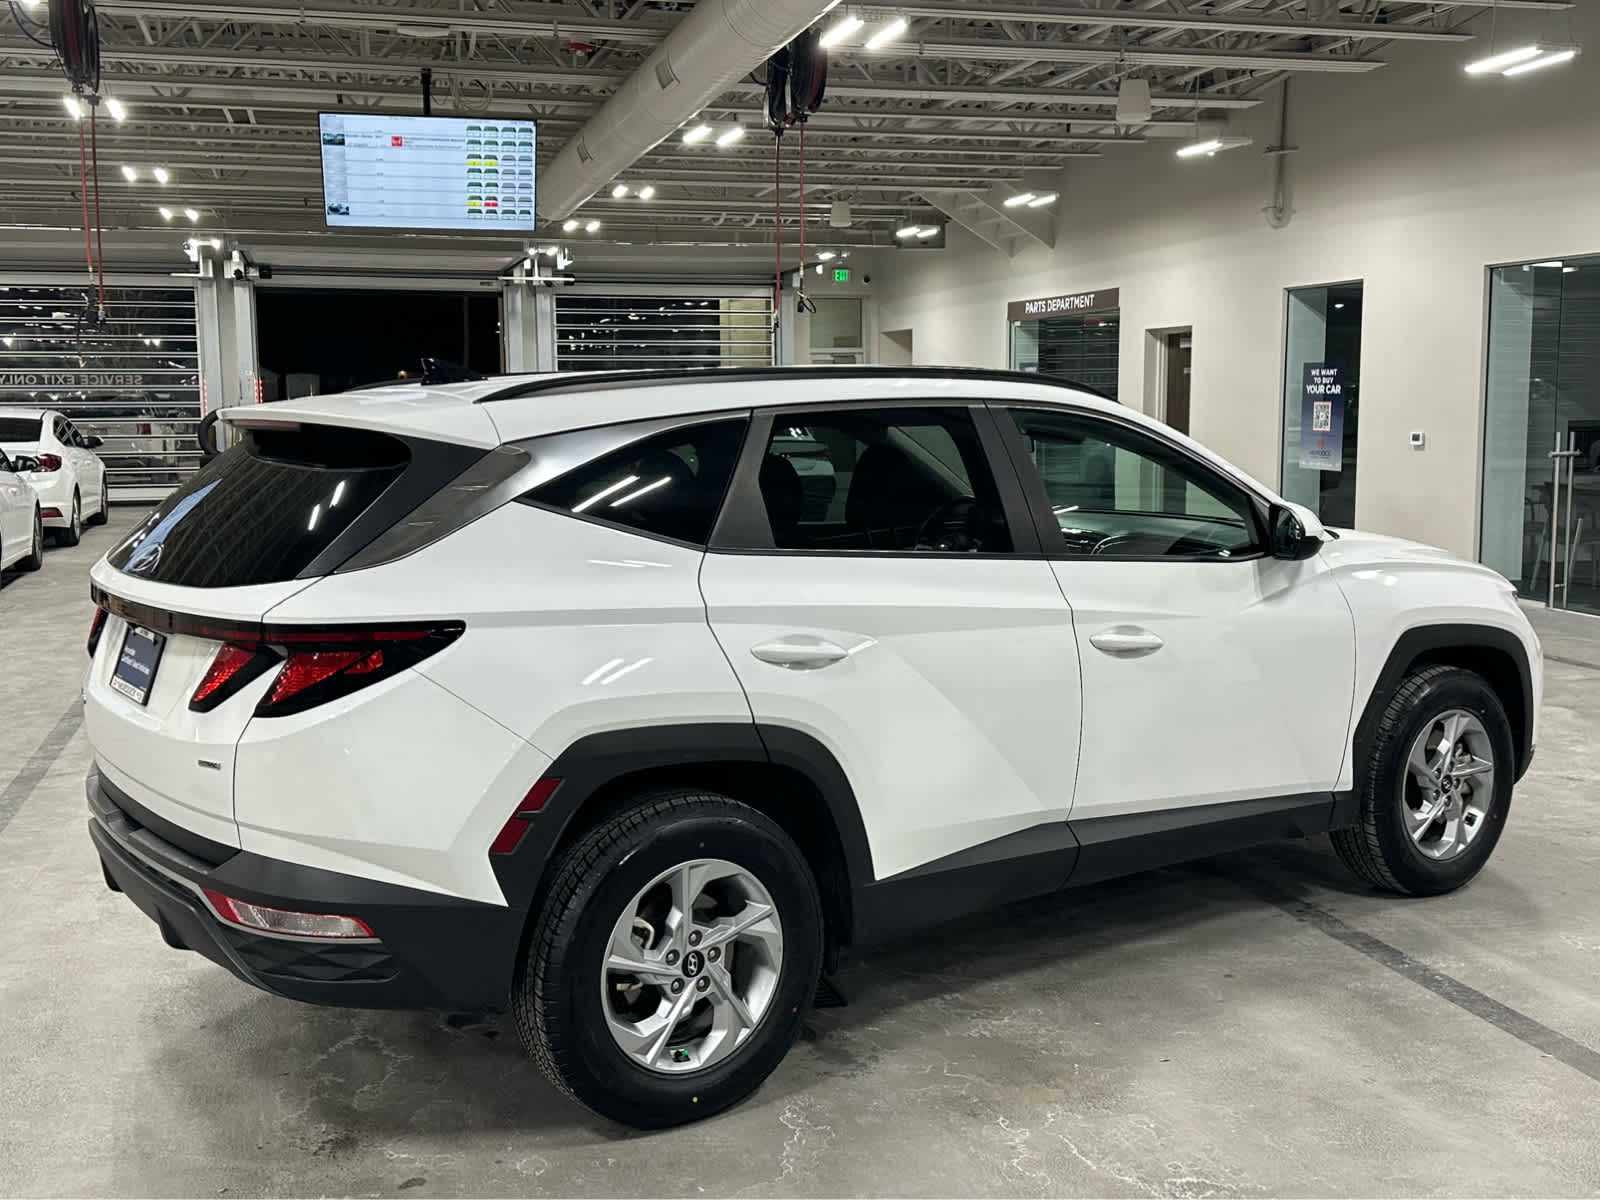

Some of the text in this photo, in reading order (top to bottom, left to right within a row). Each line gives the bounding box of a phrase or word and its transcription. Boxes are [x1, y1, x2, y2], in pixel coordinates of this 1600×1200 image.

[1025, 294, 1095, 314] PARTS DEPARTMENT
[1311, 368, 1320, 376] WE
[1306, 384, 1341, 394] YOUR CAR
